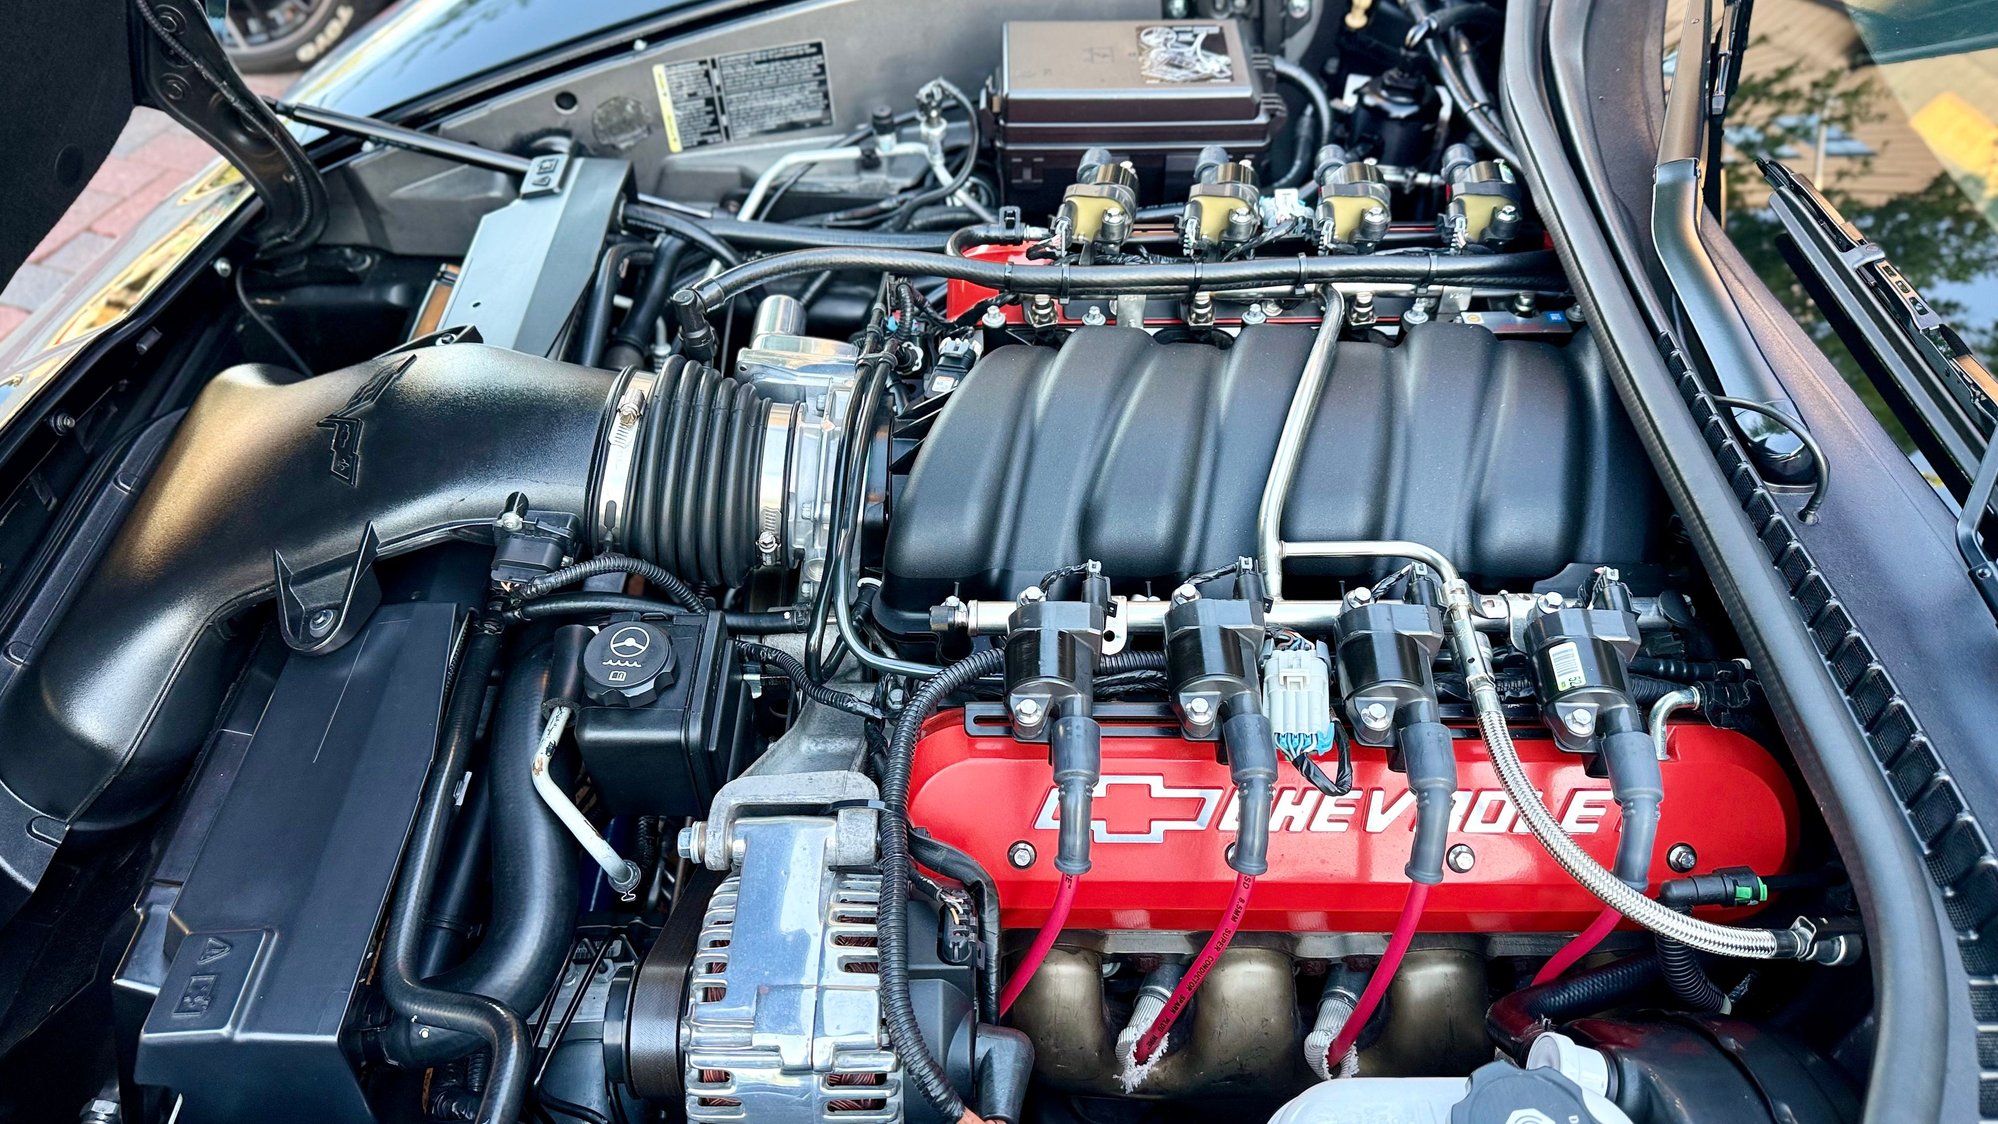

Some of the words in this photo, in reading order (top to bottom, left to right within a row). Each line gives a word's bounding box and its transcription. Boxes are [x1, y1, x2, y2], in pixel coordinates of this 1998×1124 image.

[1217, 788, 1623, 834] HEVOE
[1230, 897, 1246, 923] 8.5MM
[1214, 927, 1232, 952] SUPER
[1186, 955, 1214, 992] CONDUCTOR
[1170, 994, 1186, 1014] SPARK
